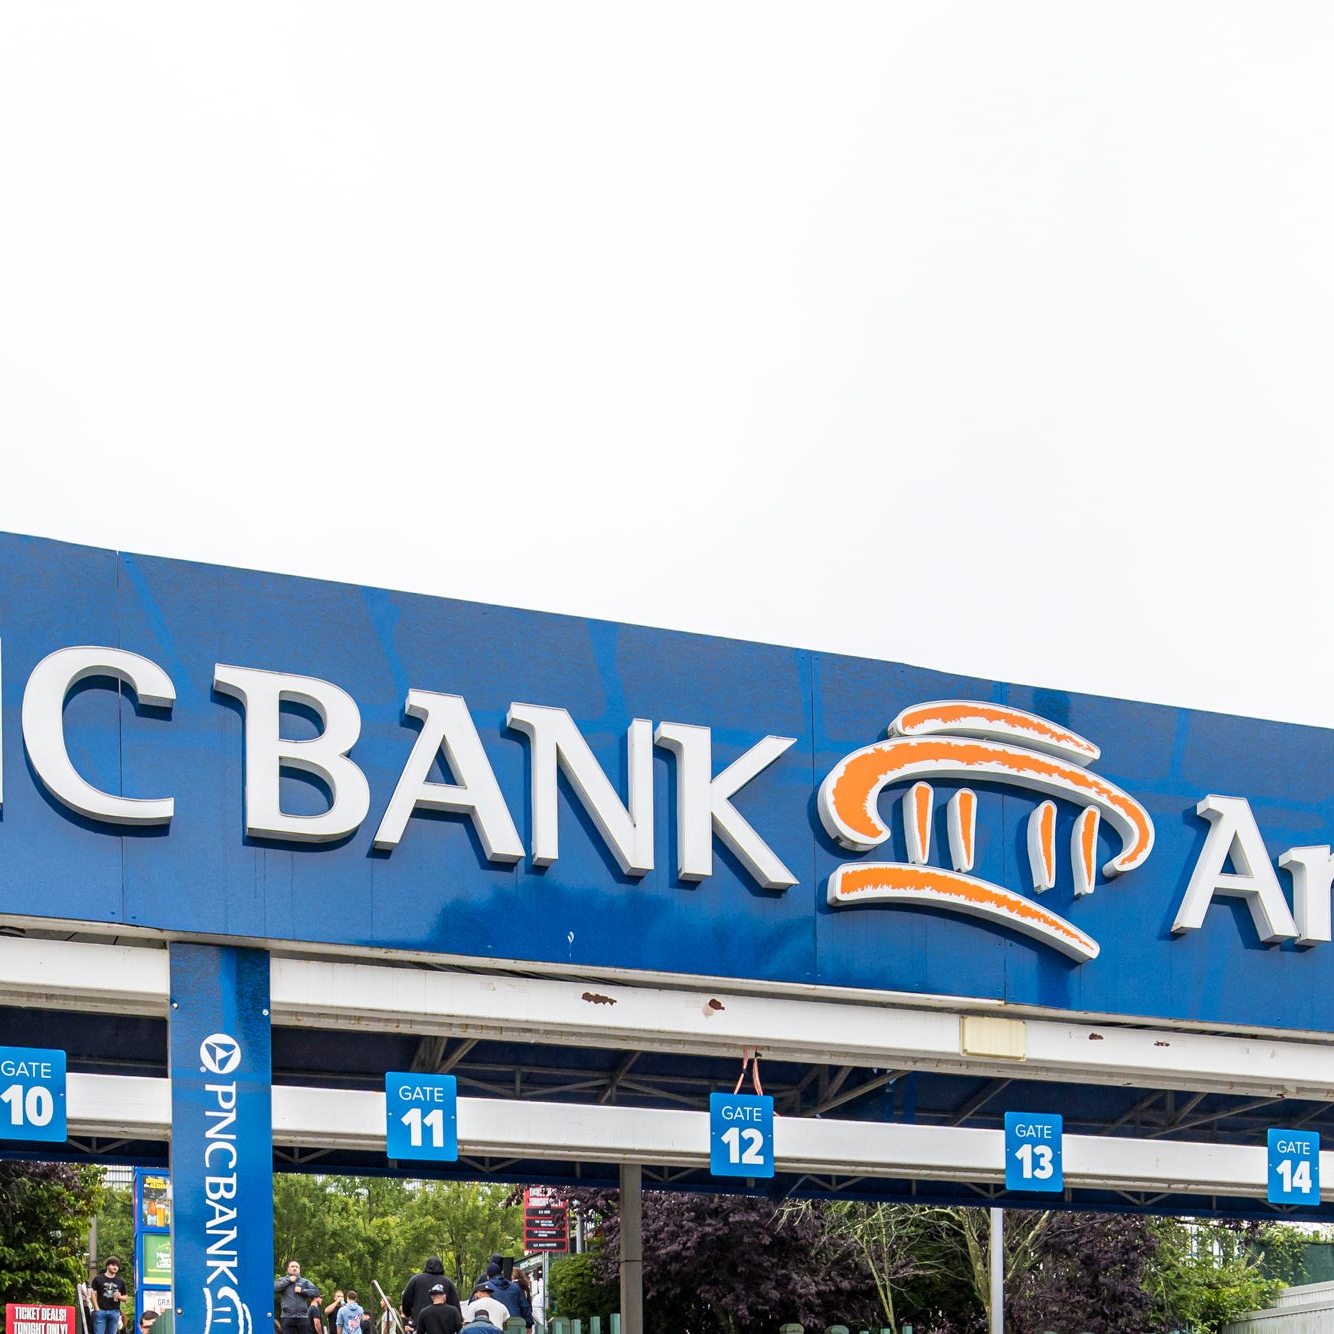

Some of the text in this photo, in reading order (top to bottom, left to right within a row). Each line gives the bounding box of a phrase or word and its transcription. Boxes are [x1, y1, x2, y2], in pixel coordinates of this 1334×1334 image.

[214, 663, 798, 889] BANK
[0, 1060, 52, 1077] GATE
[0, 1084, 54, 1127] 10
[398, 1085, 444, 1102] GATE
[204, 1081, 236, 1170] PNC
[401, 1108, 445, 1148] 11
[721, 1105, 762, 1121] GATE
[721, 1127, 764, 1165] 12
[1015, 1124, 1052, 1138] GATE
[1277, 1140, 1311, 1155] GATE
[1014, 1144, 1054, 1180] 13
[1275, 1159, 1313, 1194] 14
[205, 1174, 238, 1285] BANK
[15, 1307, 67, 1321] TICKET DEALS!
